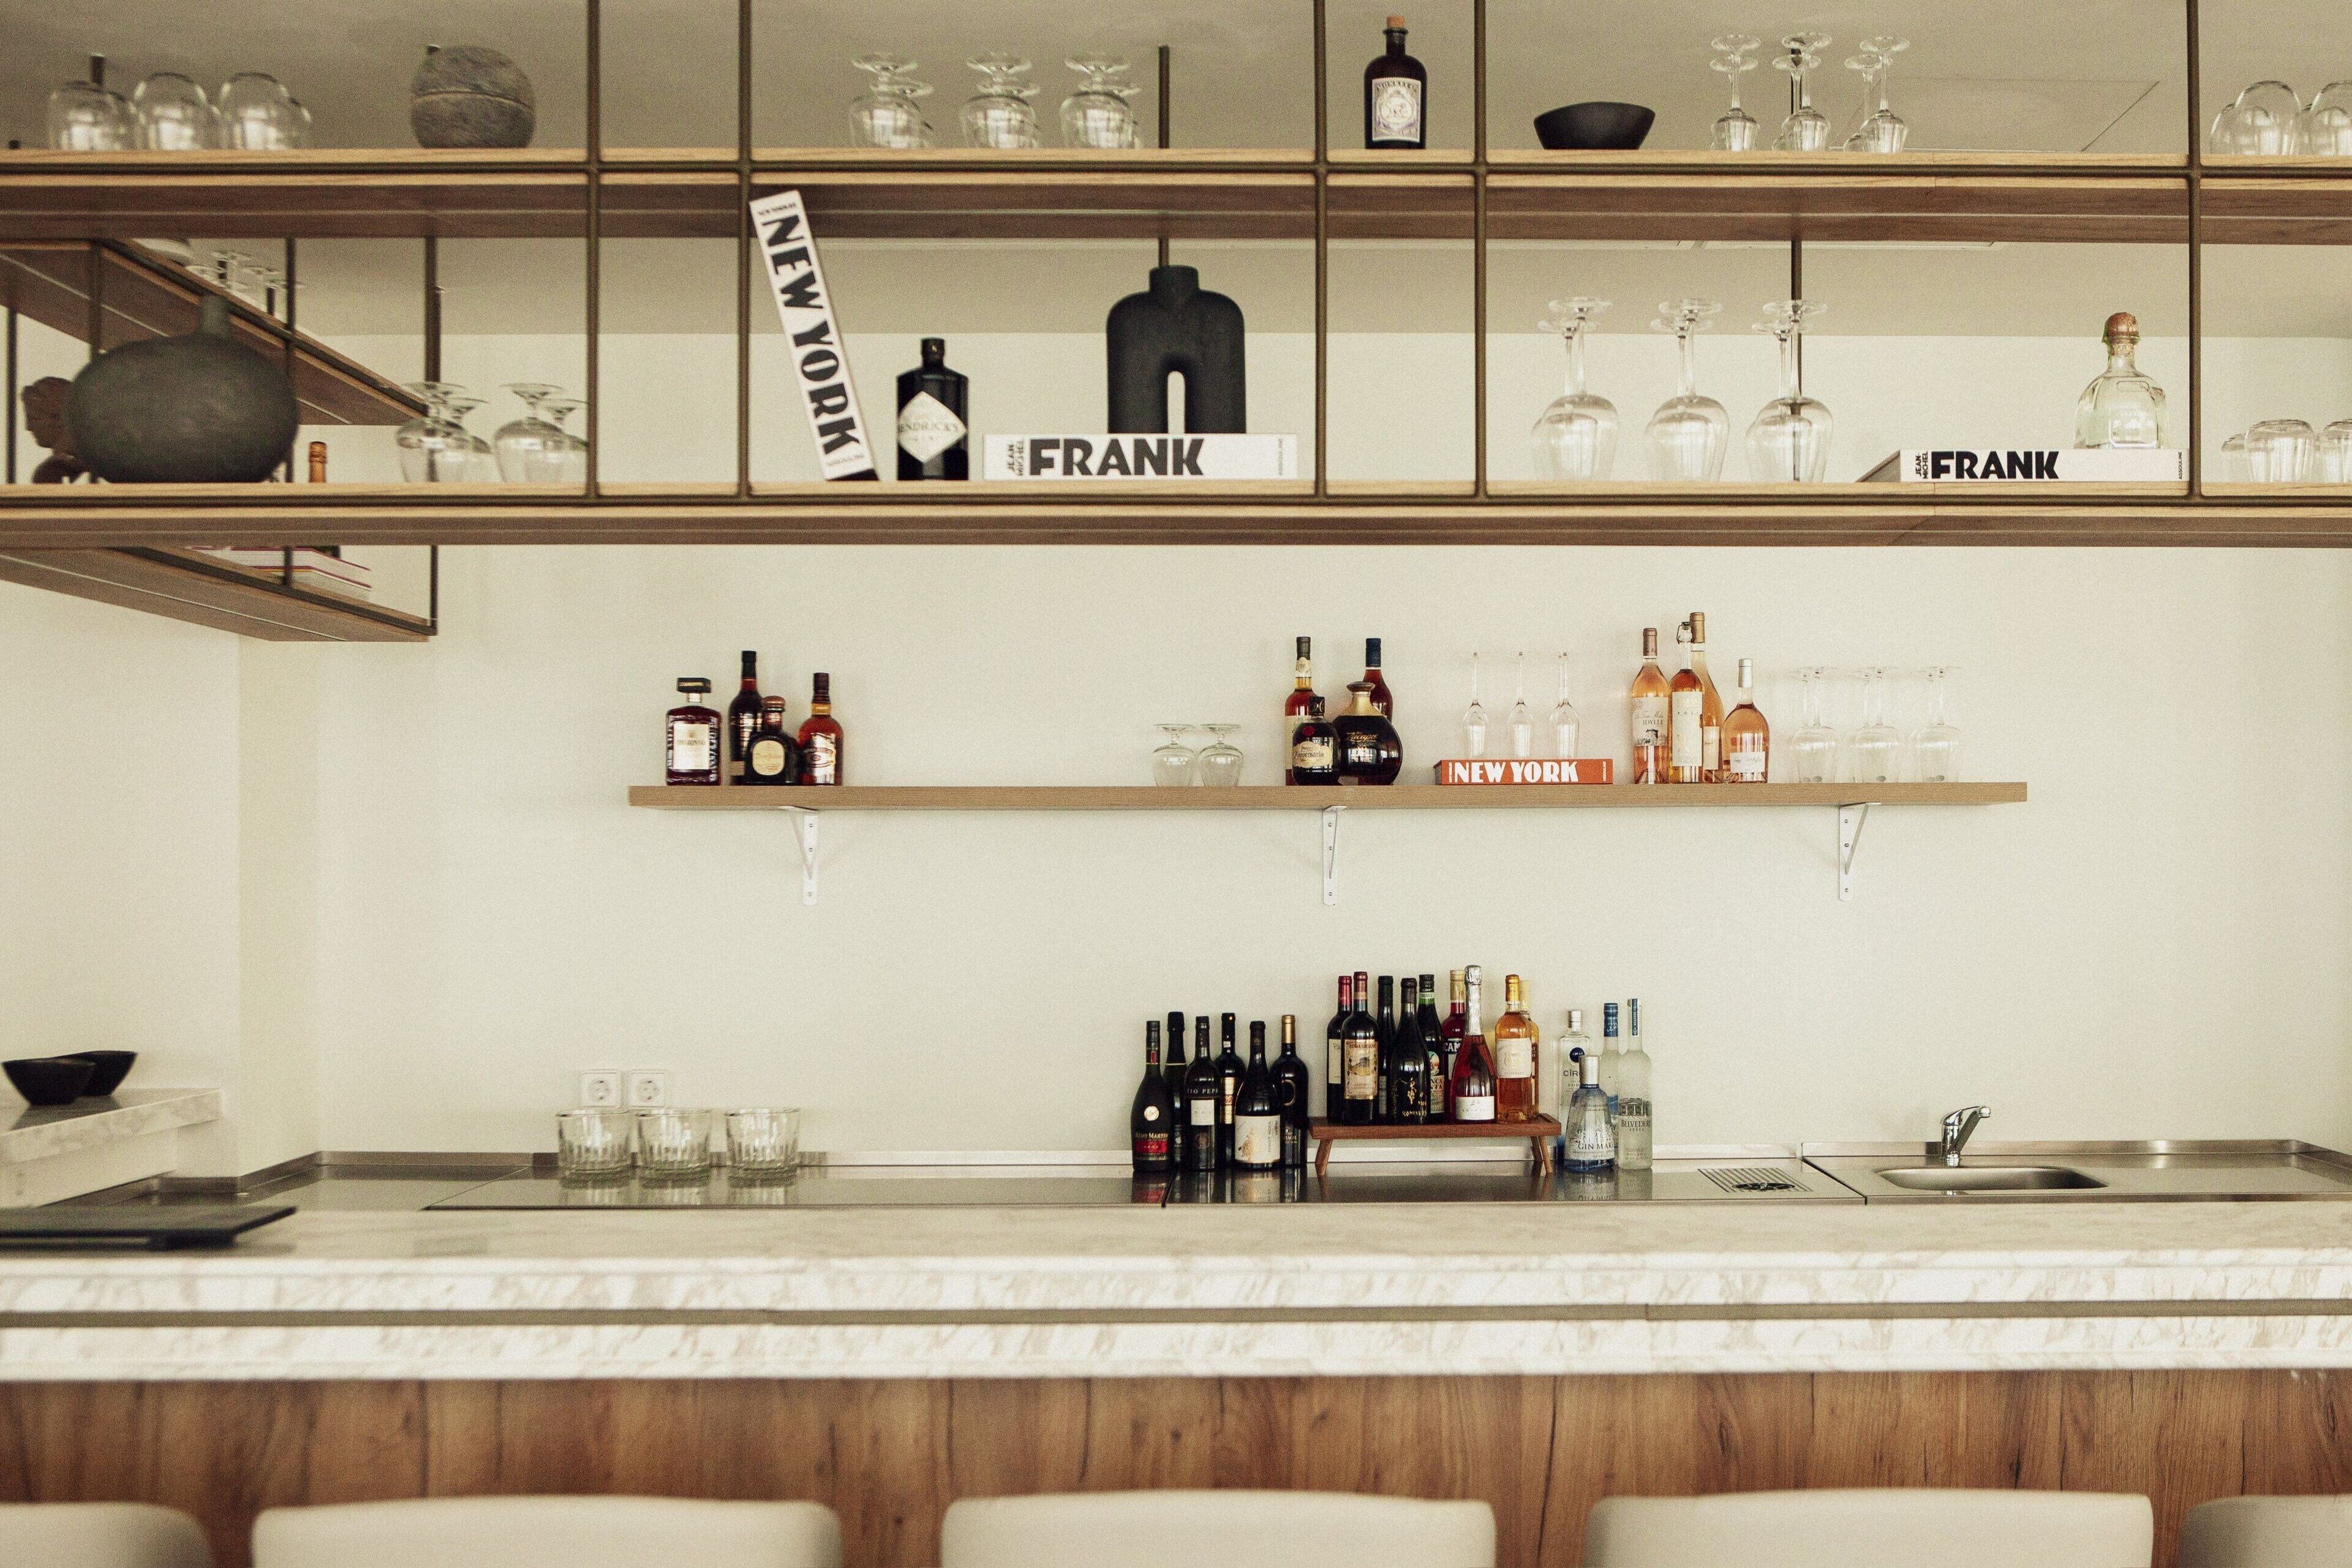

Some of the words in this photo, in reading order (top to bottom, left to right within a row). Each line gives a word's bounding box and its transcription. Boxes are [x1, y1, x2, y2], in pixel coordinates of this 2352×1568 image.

[762, 214, 823, 309] NEW
[793, 320, 860, 455] YORK
[1030, 439, 1204, 476] FRANK
[1931, 451, 2059, 479] FRANK
[1455, 762, 1506, 783] NEW
[1510, 761, 1579, 783] YORK
